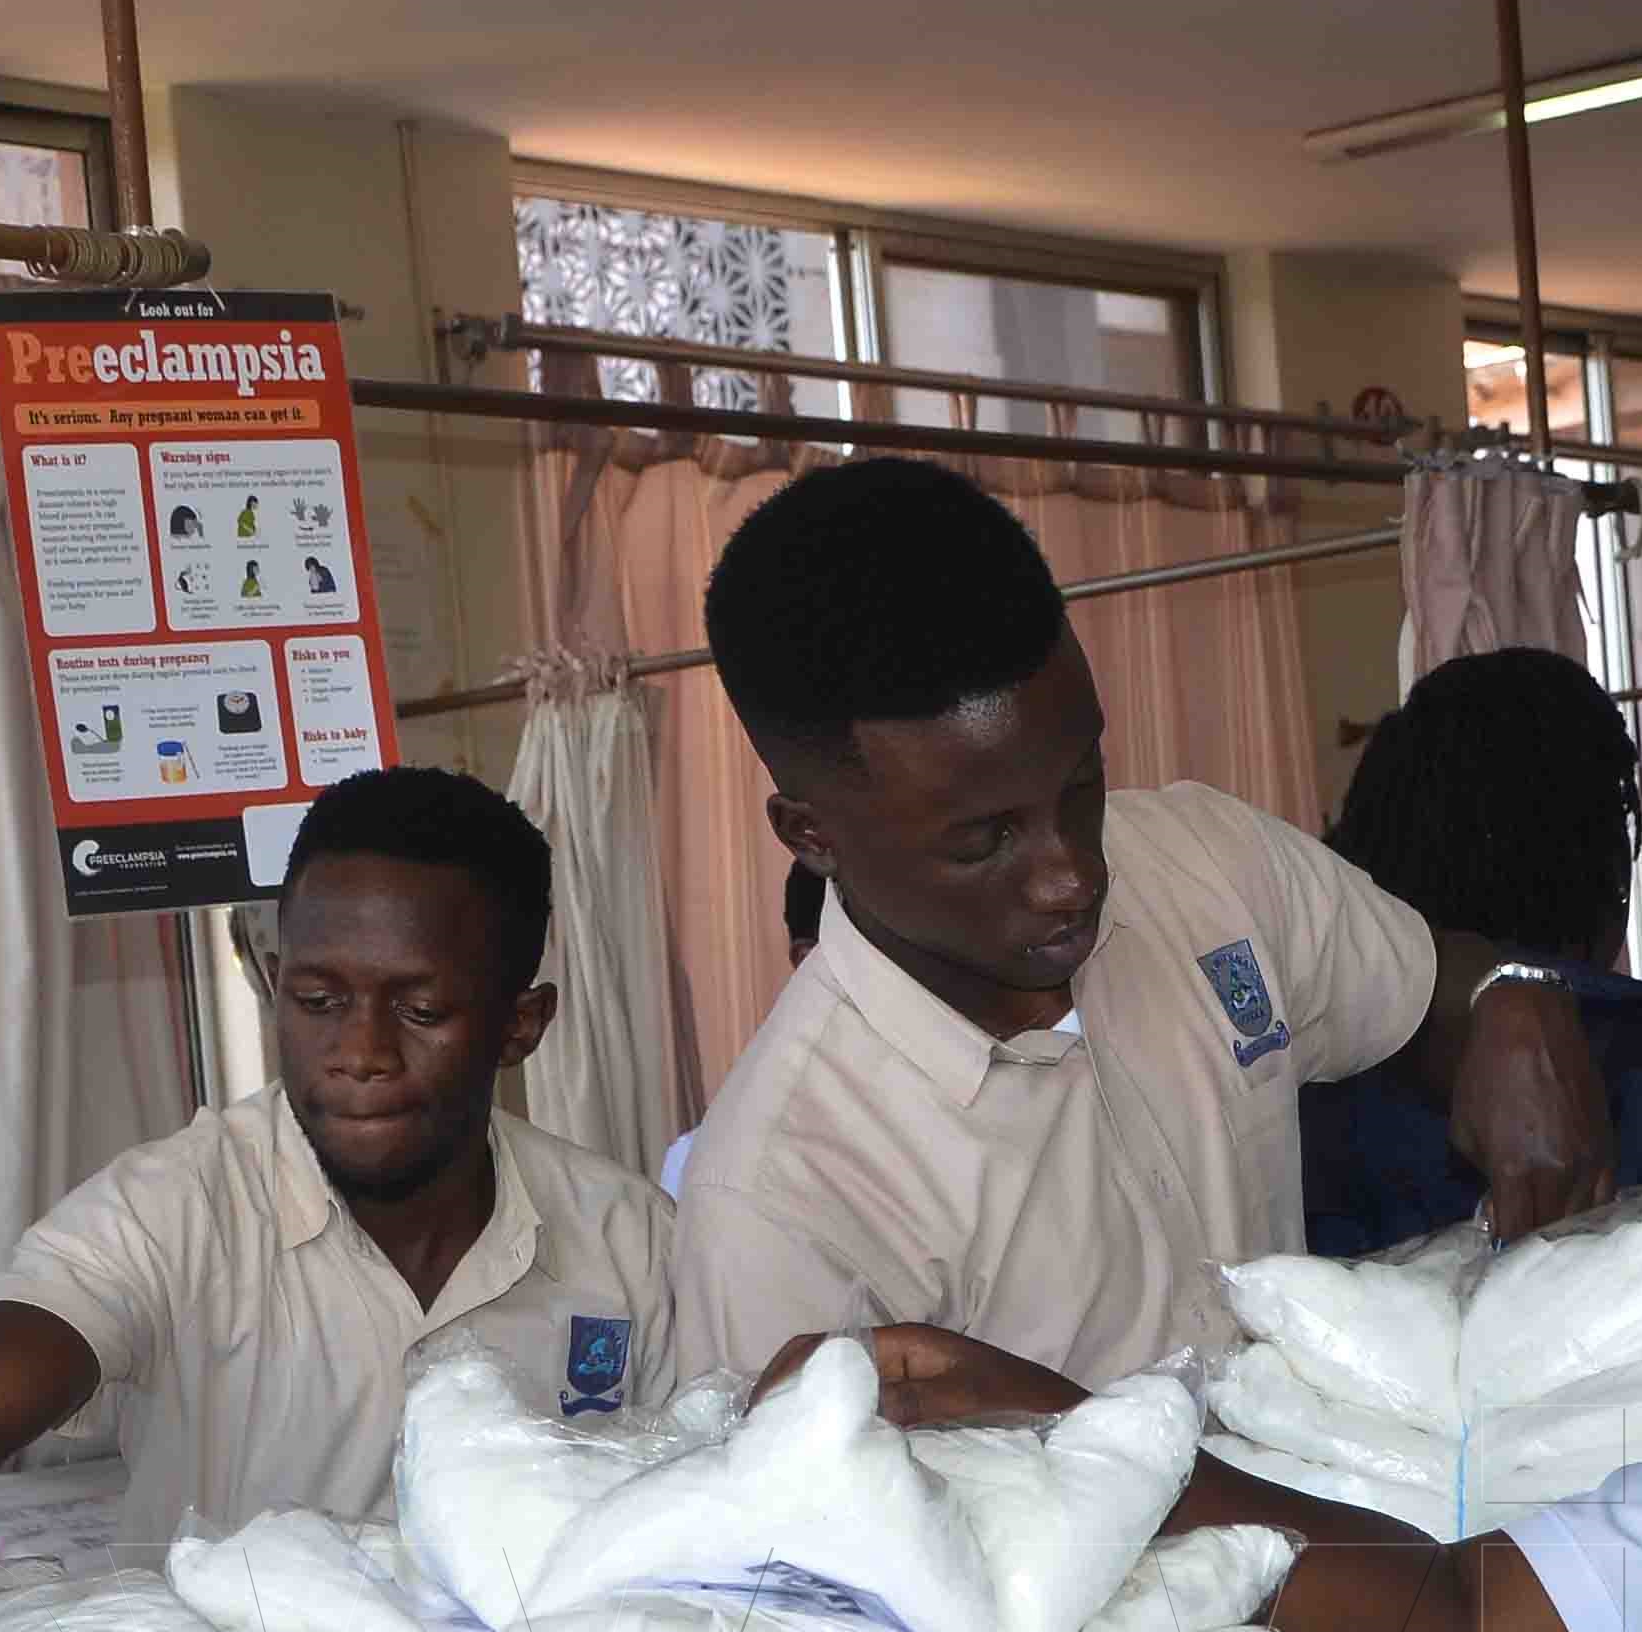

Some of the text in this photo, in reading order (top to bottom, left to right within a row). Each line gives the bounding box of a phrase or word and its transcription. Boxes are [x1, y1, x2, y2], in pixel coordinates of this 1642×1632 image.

[140, 303, 215, 317] Look out for
[6, 329, 326, 397] Preeclampsia
[29, 410, 49, 425] It's
[53, 410, 102, 425] serious.
[110, 409, 133, 427] Any
[138, 409, 193, 427] pregnant
[197, 410, 241, 423] woman
[245, 410, 267, 421] can
[270, 408, 289, 424] get
[30, 454, 87, 467] What is it?
[161, 451, 230, 465] Warning signs
[56, 653, 210, 670] Routine tests during pregnancy
[292, 650, 350, 662] Risks to you
[303, 727, 366, 742] Risks to baby
[89, 850, 167, 865] PREECLAMPSIA
